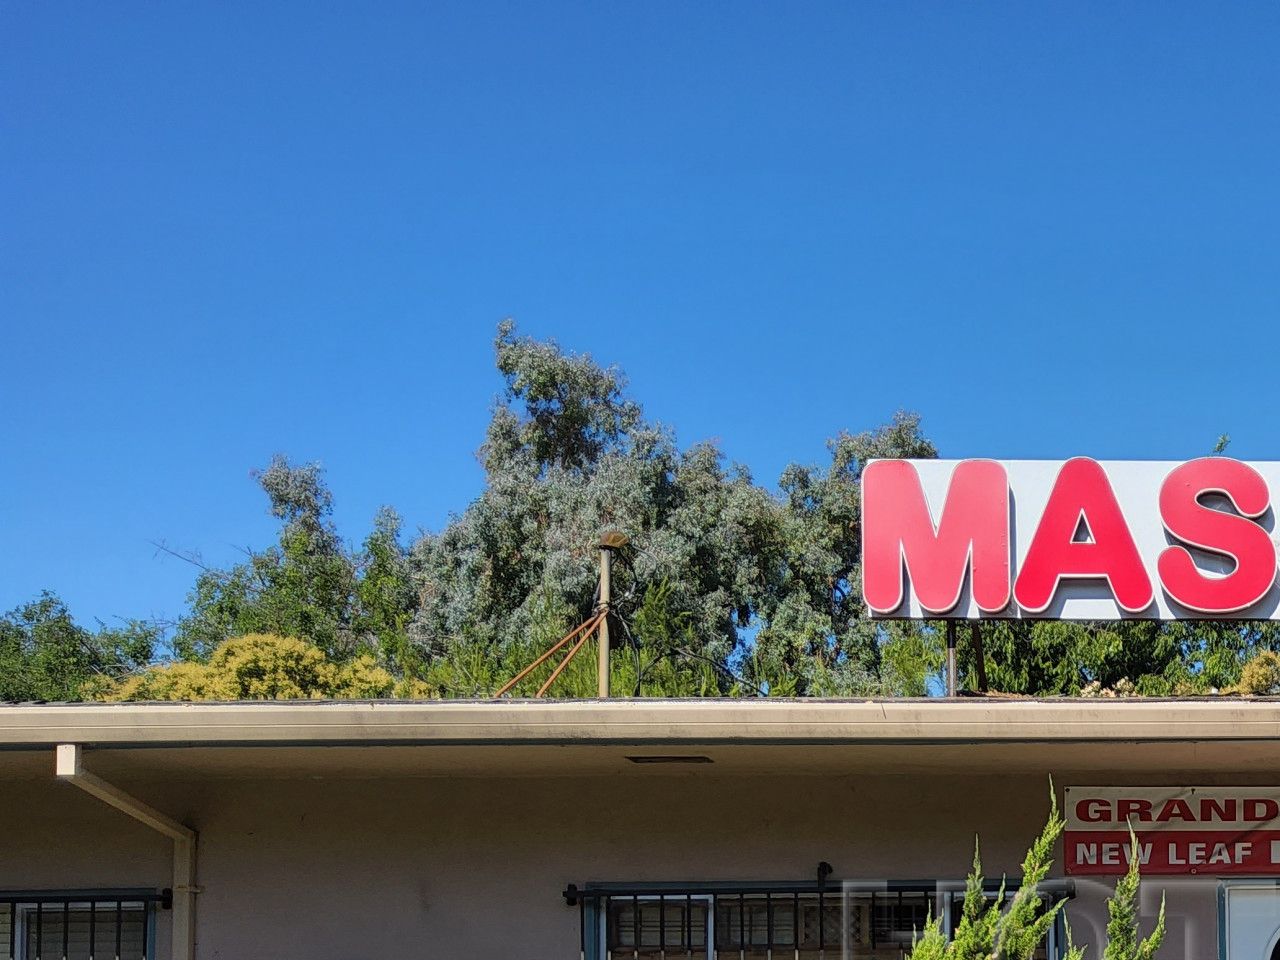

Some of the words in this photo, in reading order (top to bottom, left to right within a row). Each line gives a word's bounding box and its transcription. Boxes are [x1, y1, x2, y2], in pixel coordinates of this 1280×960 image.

[1075, 797, 1280, 823] GRAND
[1075, 843, 1152, 866] NEW
[1168, 842, 1254, 865] LEAF
